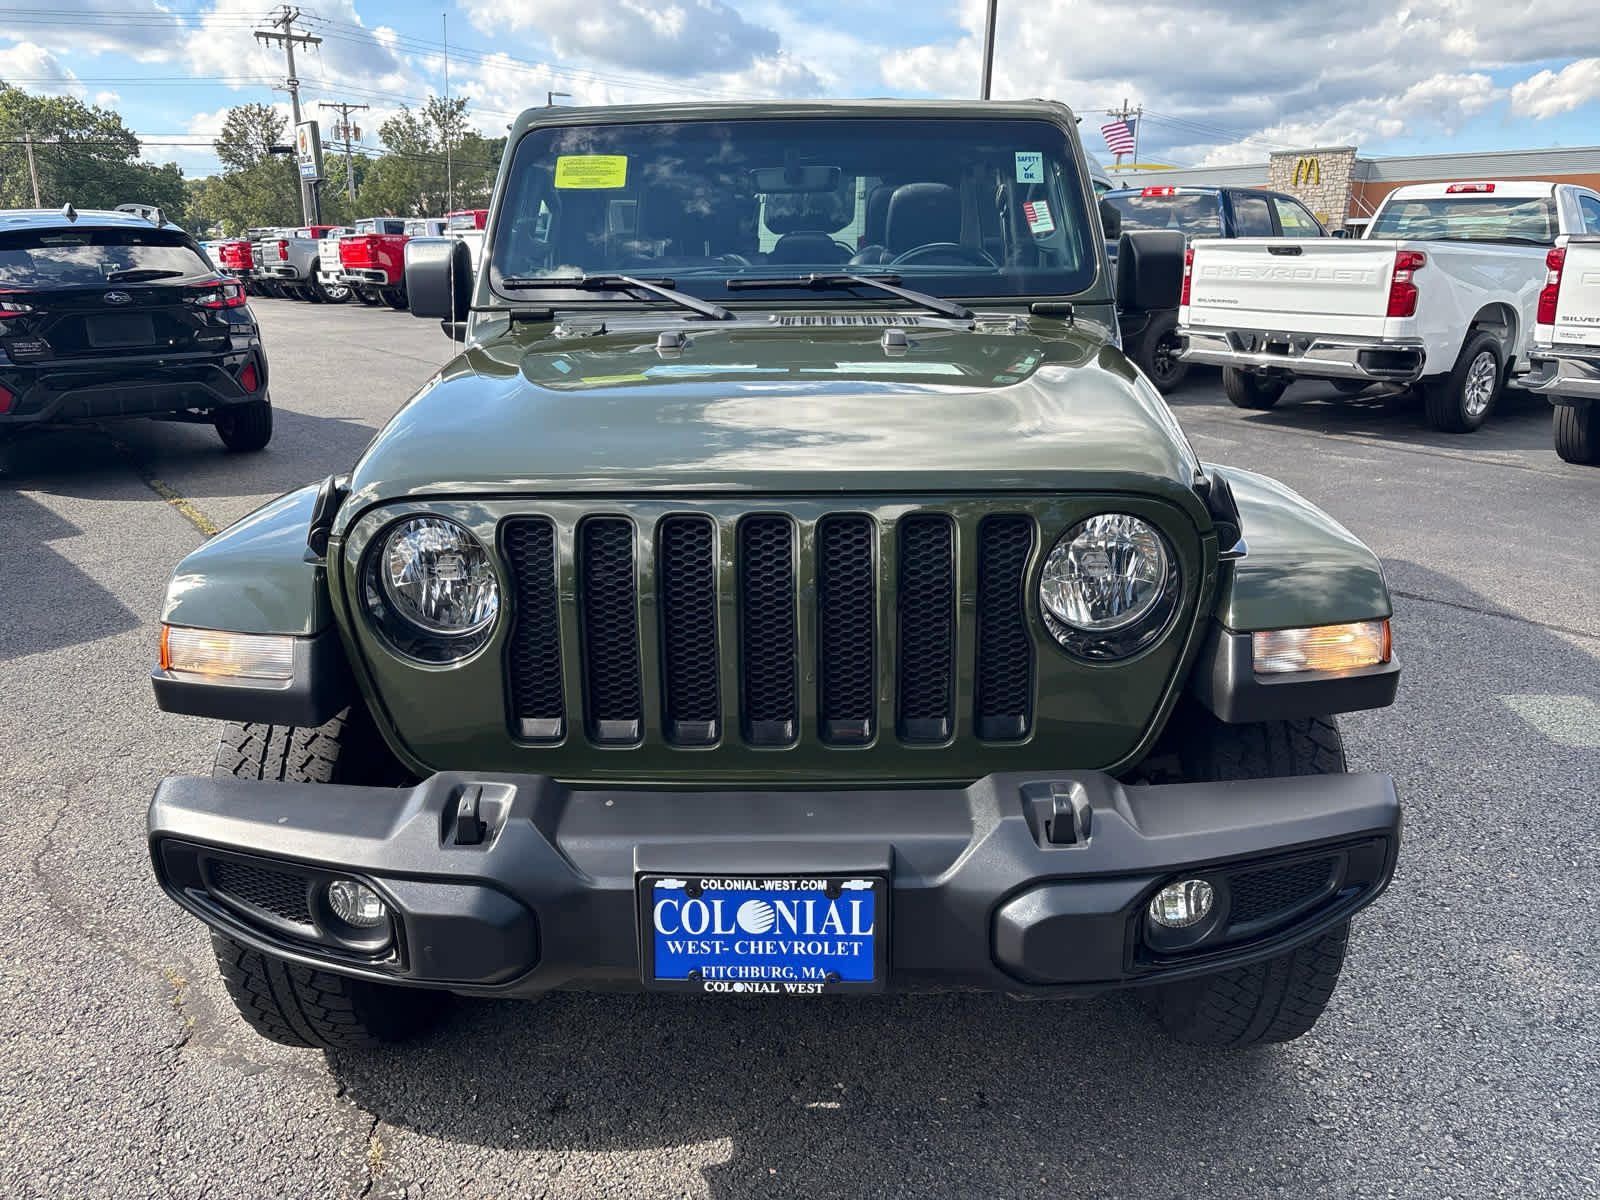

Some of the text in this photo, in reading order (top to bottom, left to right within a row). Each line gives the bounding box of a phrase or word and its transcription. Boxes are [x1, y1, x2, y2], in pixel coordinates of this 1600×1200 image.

[1200, 265, 1376, 282] CHEVROLET
[700, 879, 828, 891] COLONIAL-WEST.COM
[653, 898, 875, 936] COLONIAL
[734, 940, 863, 956] CHEVROLET
[701, 966, 827, 979] FITCHBURG, MA
[703, 981, 825, 994] COLONIAL WEST
